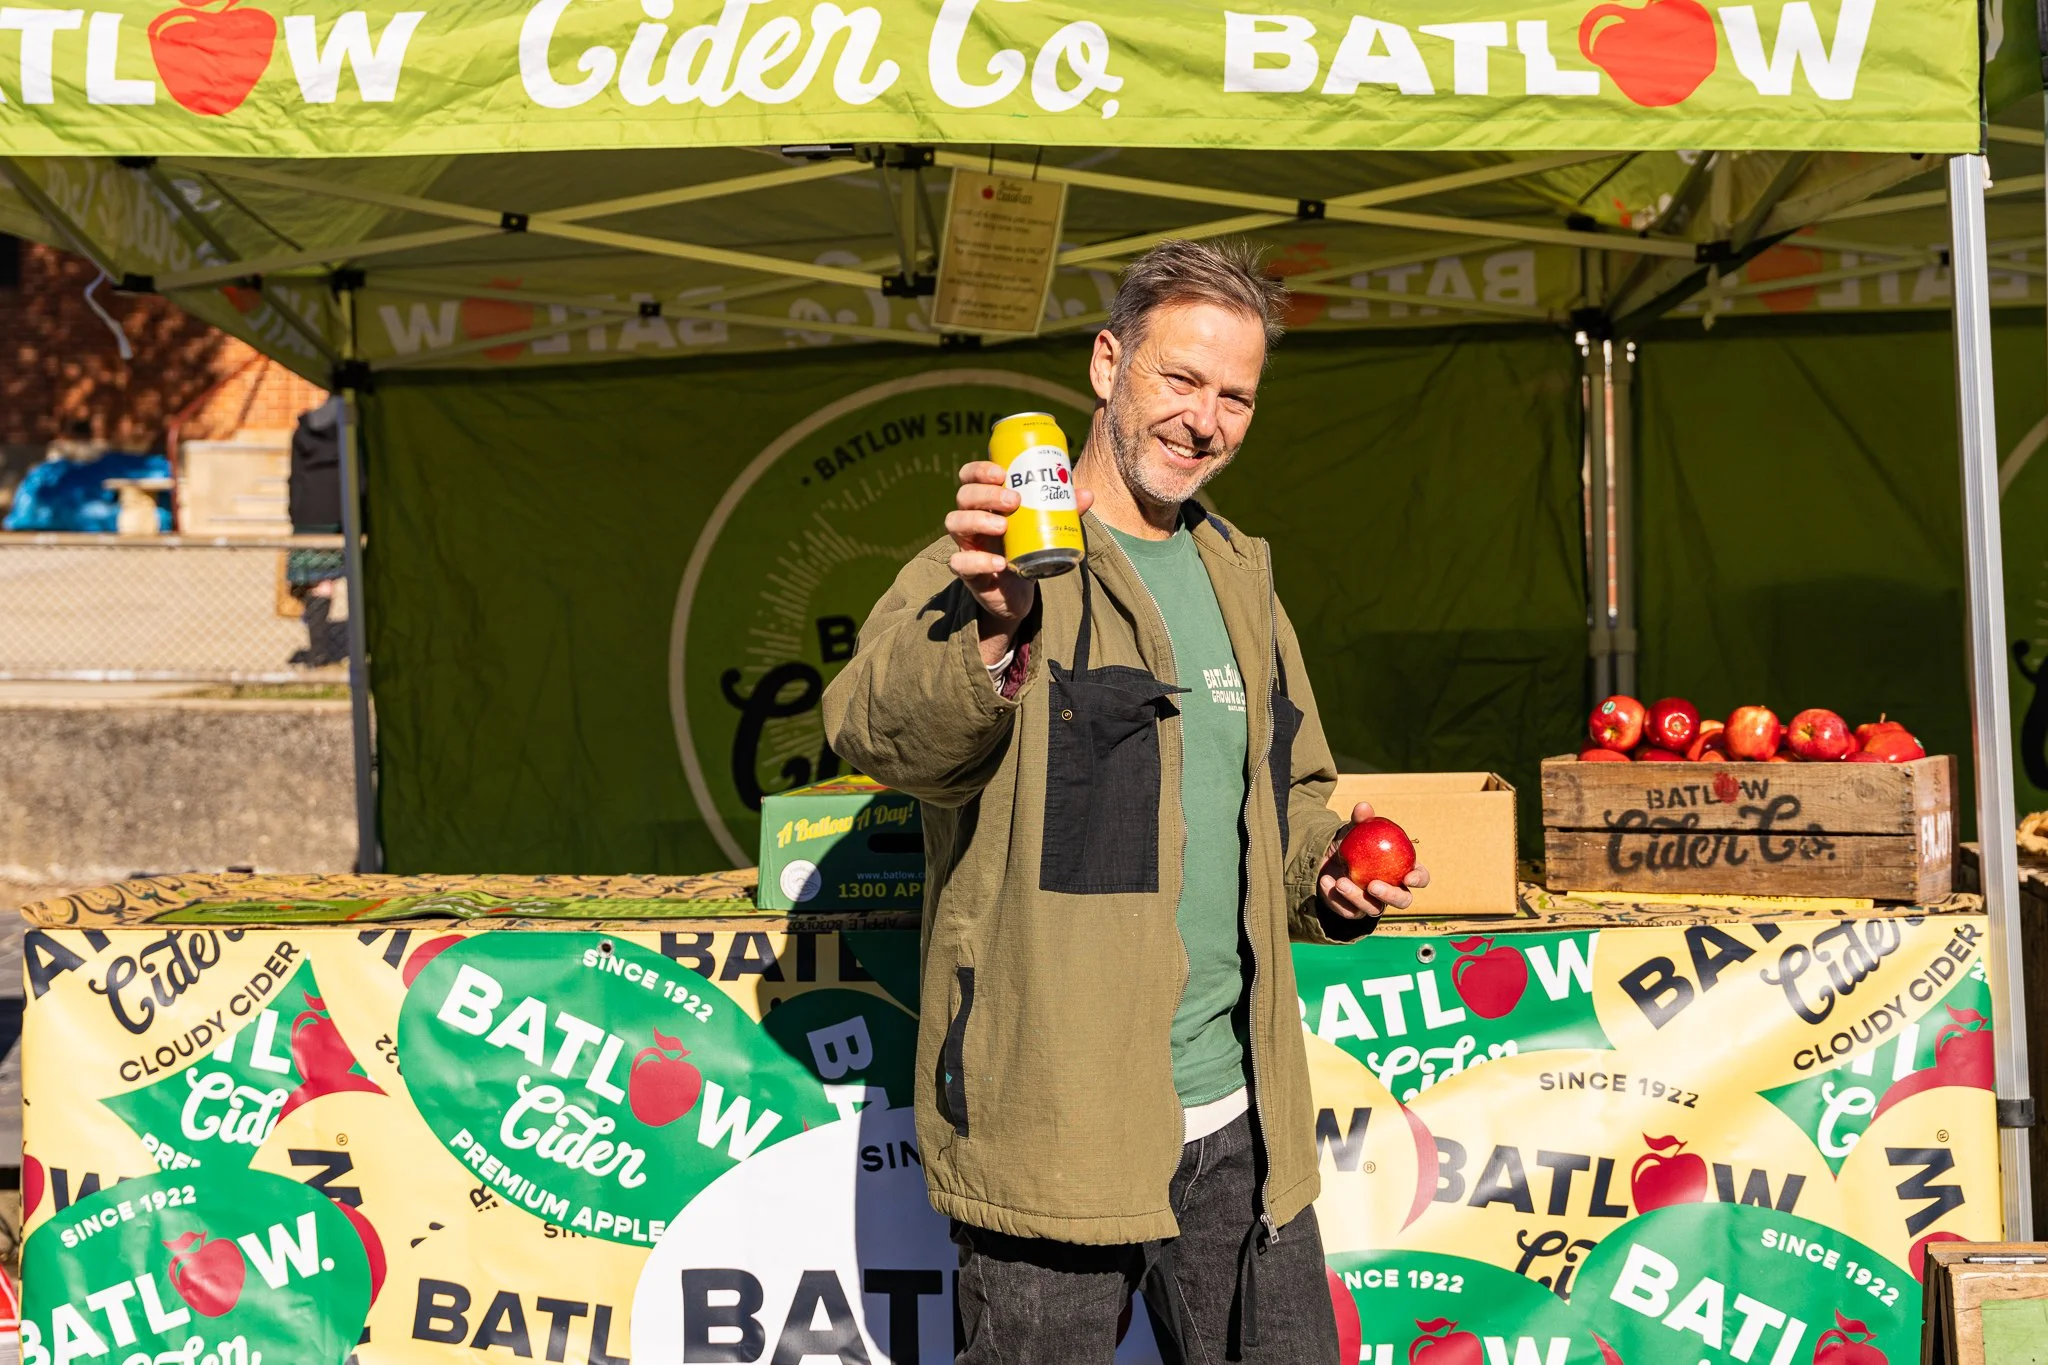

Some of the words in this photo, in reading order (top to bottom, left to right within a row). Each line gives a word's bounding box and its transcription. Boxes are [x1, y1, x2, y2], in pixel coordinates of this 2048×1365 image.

[517, 0, 900, 108] Cider
[1223, 0, 1876, 107] BATLOW
[812, 412, 927, 482] BATLOW
[873, 801, 915, 826] Day!
[1603, 808, 1748, 877] Cider
[838, 883, 887, 898] 1300
[119, 1011, 226, 1082] CLOUDY
[230, 940, 300, 1017] CIDER
[582, 947, 659, 990] SINCE
[662, 980, 714, 1023] 1922
[1793, 994, 1907, 1070] CLOUDY
[1909, 923, 1984, 1002] CIDER
[437, 964, 782, 1163] BATLOW
[1539, 1072, 1627, 1093] SINCE
[1638, 1077, 1699, 1109] 1922
[500, 1075, 647, 1189] Cider
[450, 1128, 570, 1222] PREMIUM
[571, 1206, 668, 1244] APPLE
[1433, 1132, 1806, 1219] BATLOW
[60, 1198, 136, 1249] SINCE
[140, 1184, 197, 1214] 1922
[1407, 1270, 1465, 1294] 1922
[1760, 1228, 1841, 1271] SINCE
[1845, 1261, 1899, 1308] 1922
